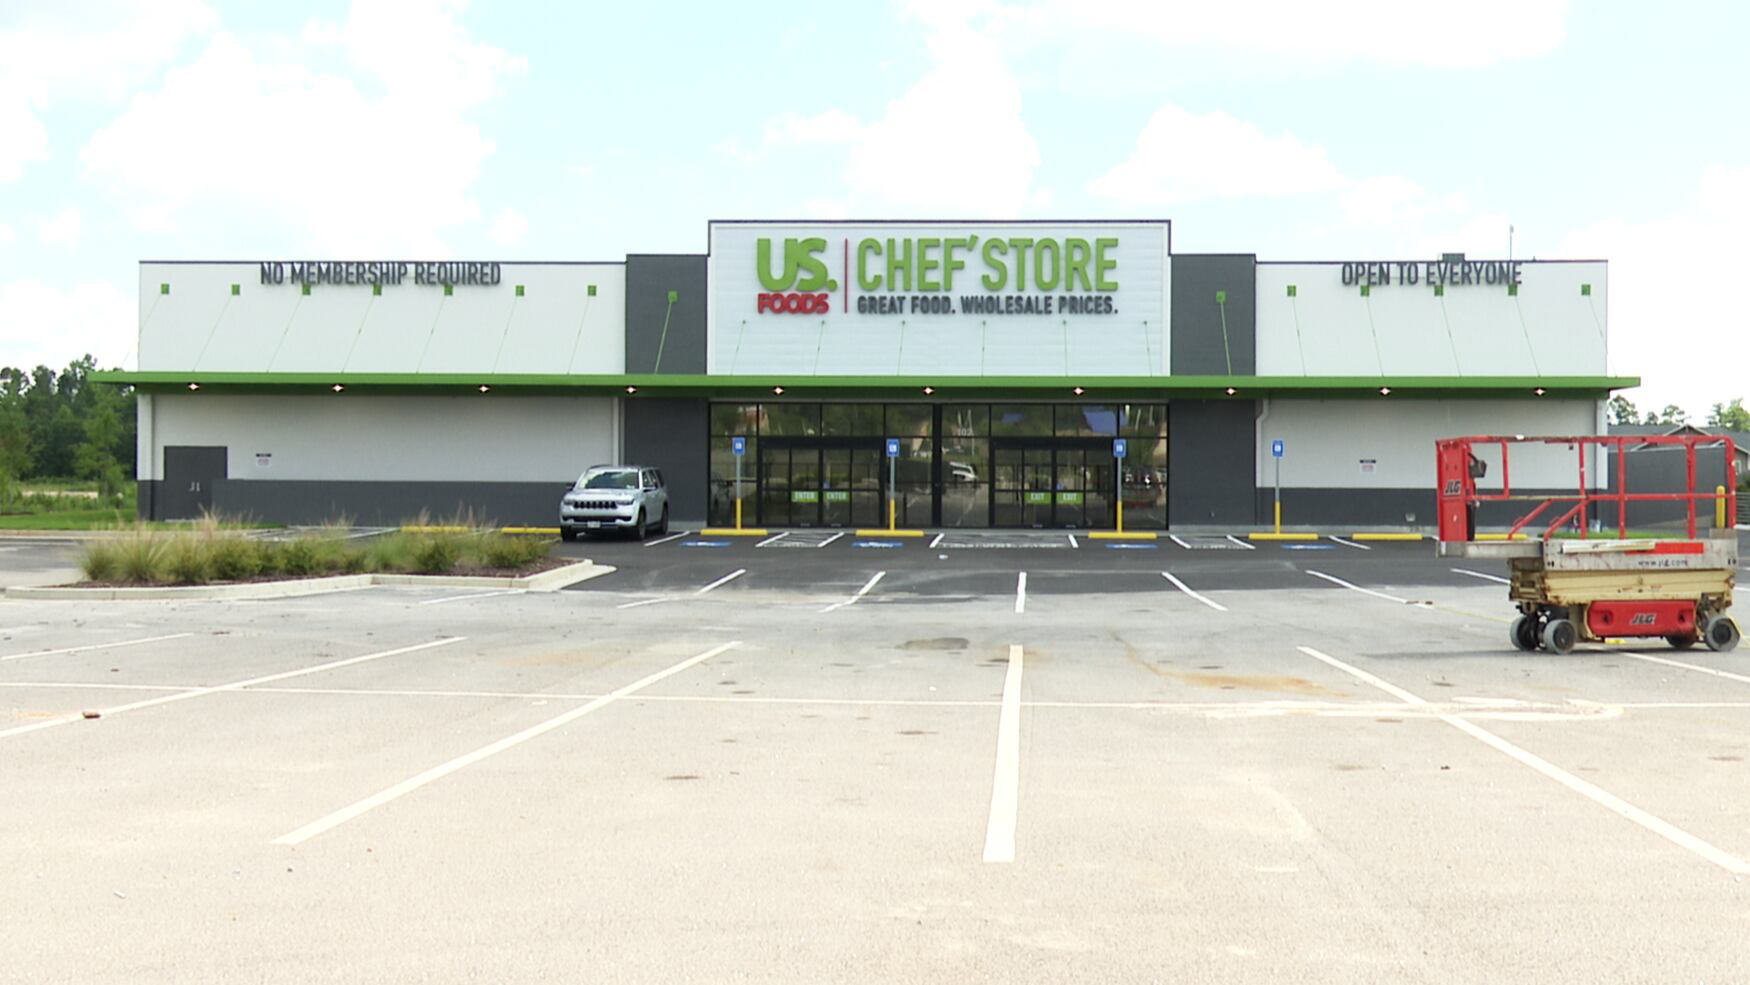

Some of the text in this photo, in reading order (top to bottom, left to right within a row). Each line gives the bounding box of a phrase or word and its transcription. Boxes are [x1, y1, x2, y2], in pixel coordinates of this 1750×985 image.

[260, 262, 501, 285] NO MEMBERSHIP REQUIRED
[757, 238, 838, 292] US.
[1341, 262, 1522, 286] OPEN TO EVERYONE
[757, 293, 830, 314] FOODS
[857, 295, 1119, 315] GREAT FOOD. WHOLESALE PRICES.
[1444, 480, 1461, 495] JLG
[1631, 612, 1656, 625] JLG
